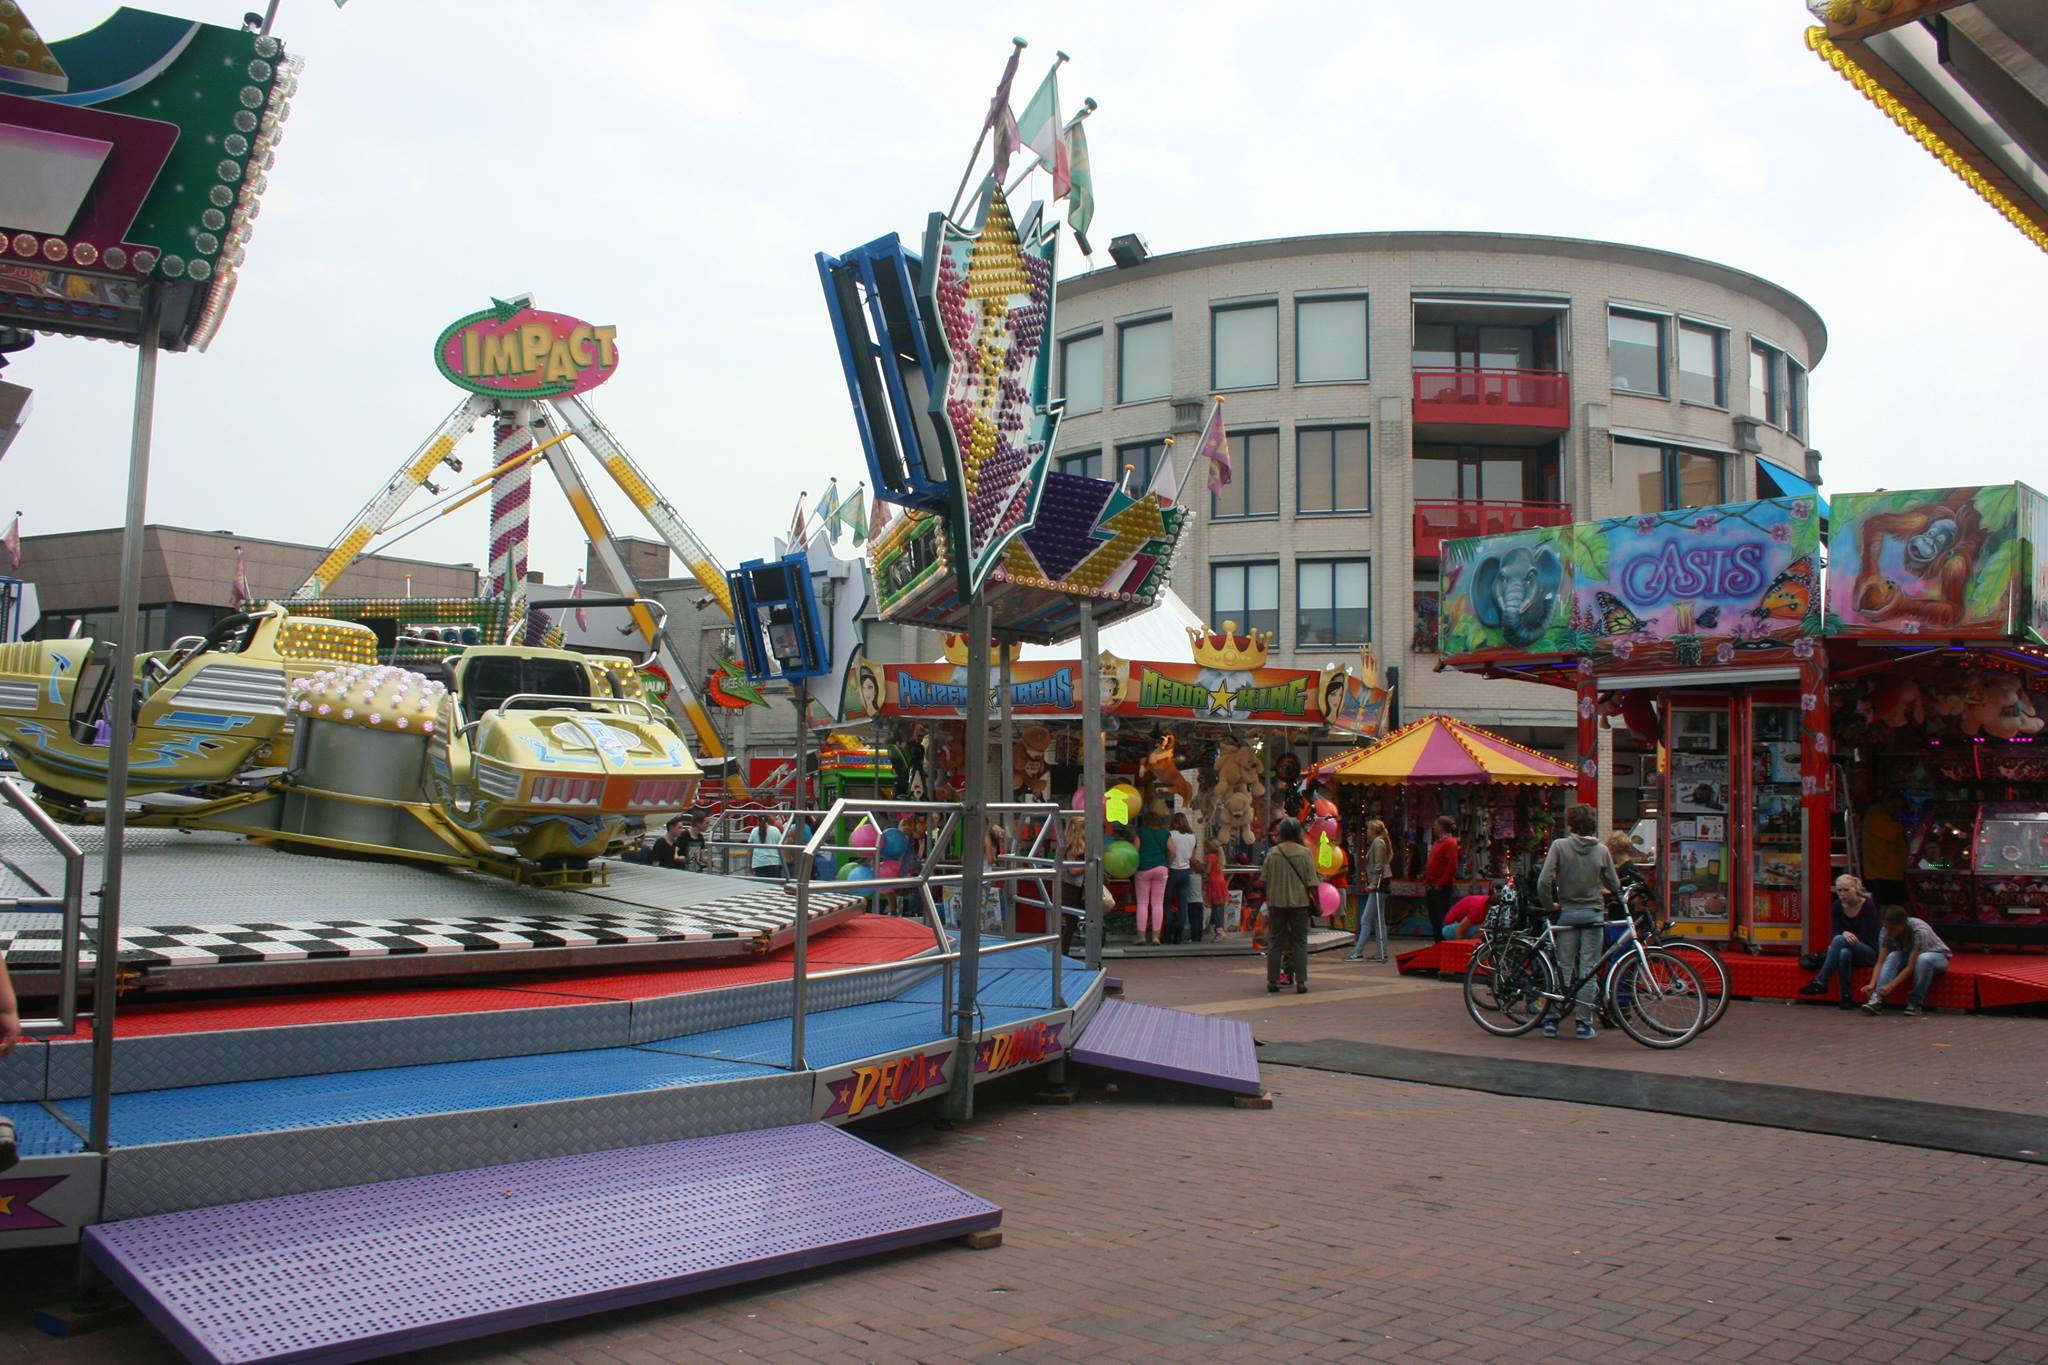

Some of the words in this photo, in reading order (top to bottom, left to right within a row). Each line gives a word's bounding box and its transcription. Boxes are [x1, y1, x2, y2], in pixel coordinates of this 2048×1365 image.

[463, 323, 617, 383] IMPACT
[1622, 540, 1766, 606] OASIS
[1137, 666, 1209, 710] MEDIA
[1234, 675, 1310, 716] KING
[988, 1022, 1048, 1073] DANCE
[848, 1053, 927, 1116] DECA
